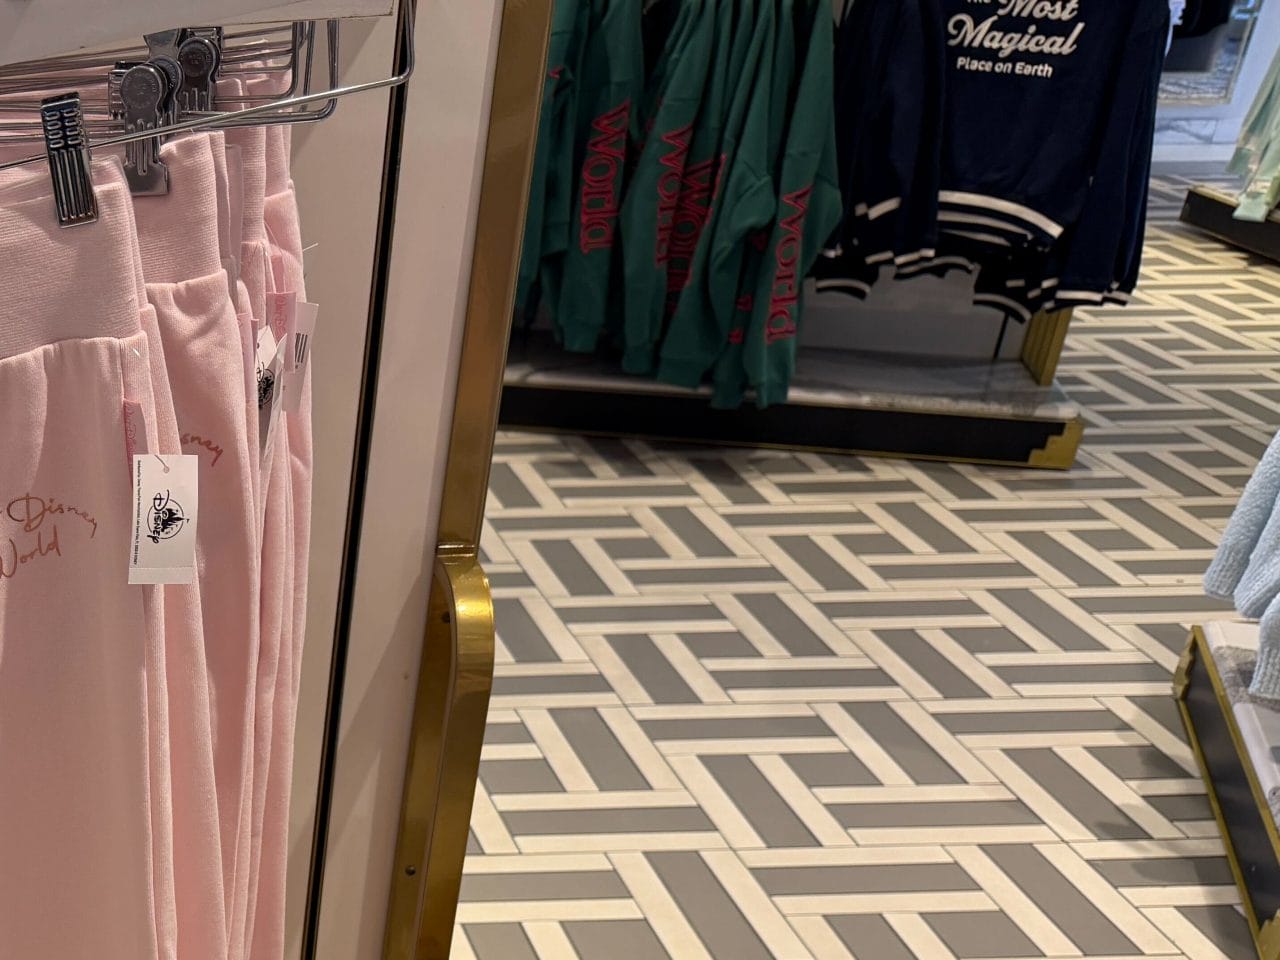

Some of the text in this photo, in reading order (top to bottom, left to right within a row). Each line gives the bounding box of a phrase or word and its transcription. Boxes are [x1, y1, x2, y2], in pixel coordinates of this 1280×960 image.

[947, 13, 1086, 58] Magical
[956, 56, 1054, 79] Place on Earth
[580, 98, 632, 255] World
[765, 184, 813, 344] World
[180, 433, 224, 467] sney
[6, 492, 98, 538] Disney
